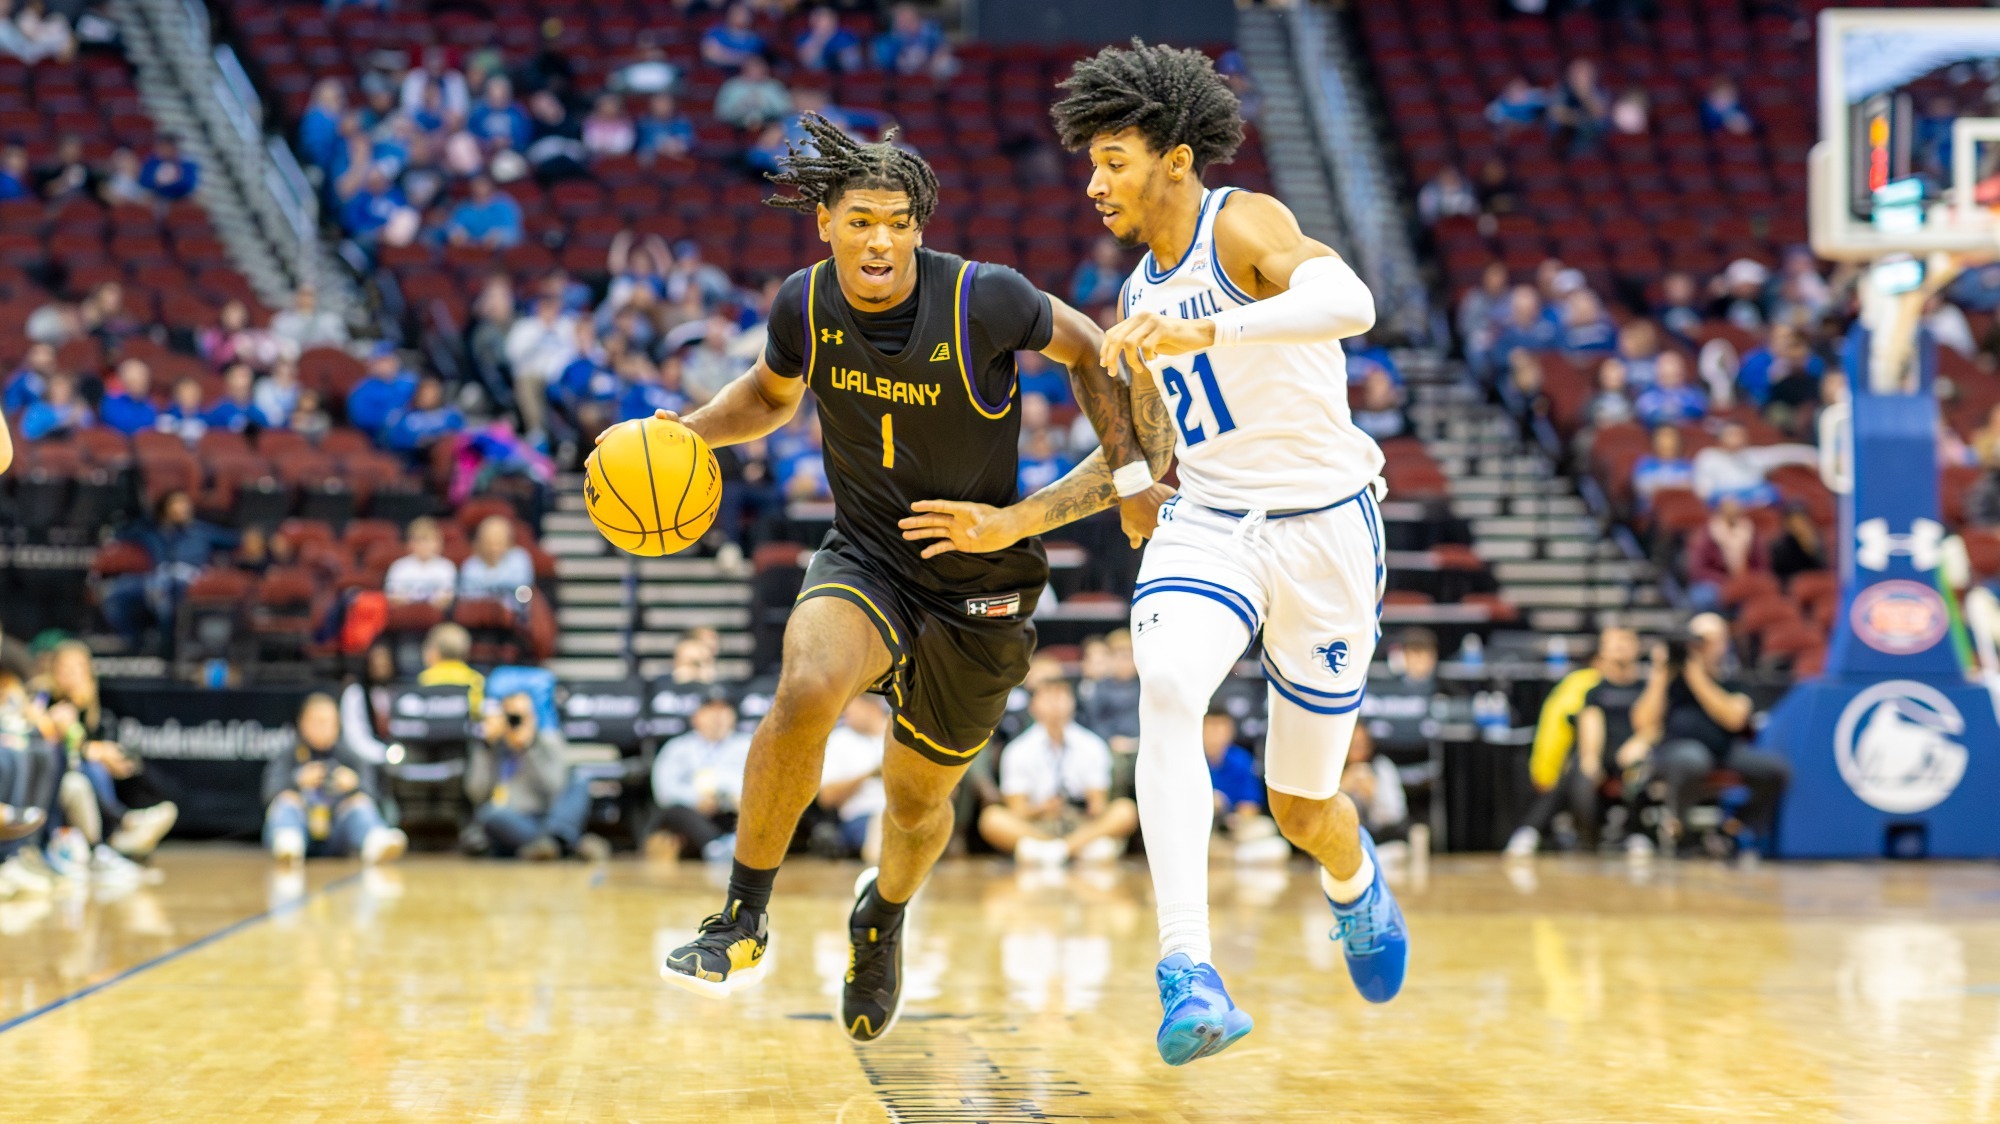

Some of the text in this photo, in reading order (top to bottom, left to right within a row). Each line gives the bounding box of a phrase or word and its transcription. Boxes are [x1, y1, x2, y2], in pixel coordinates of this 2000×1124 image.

[831, 366, 941, 406] UALBANY
[1162, 351, 1237, 447] 21
[881, 413, 895, 469] 1
